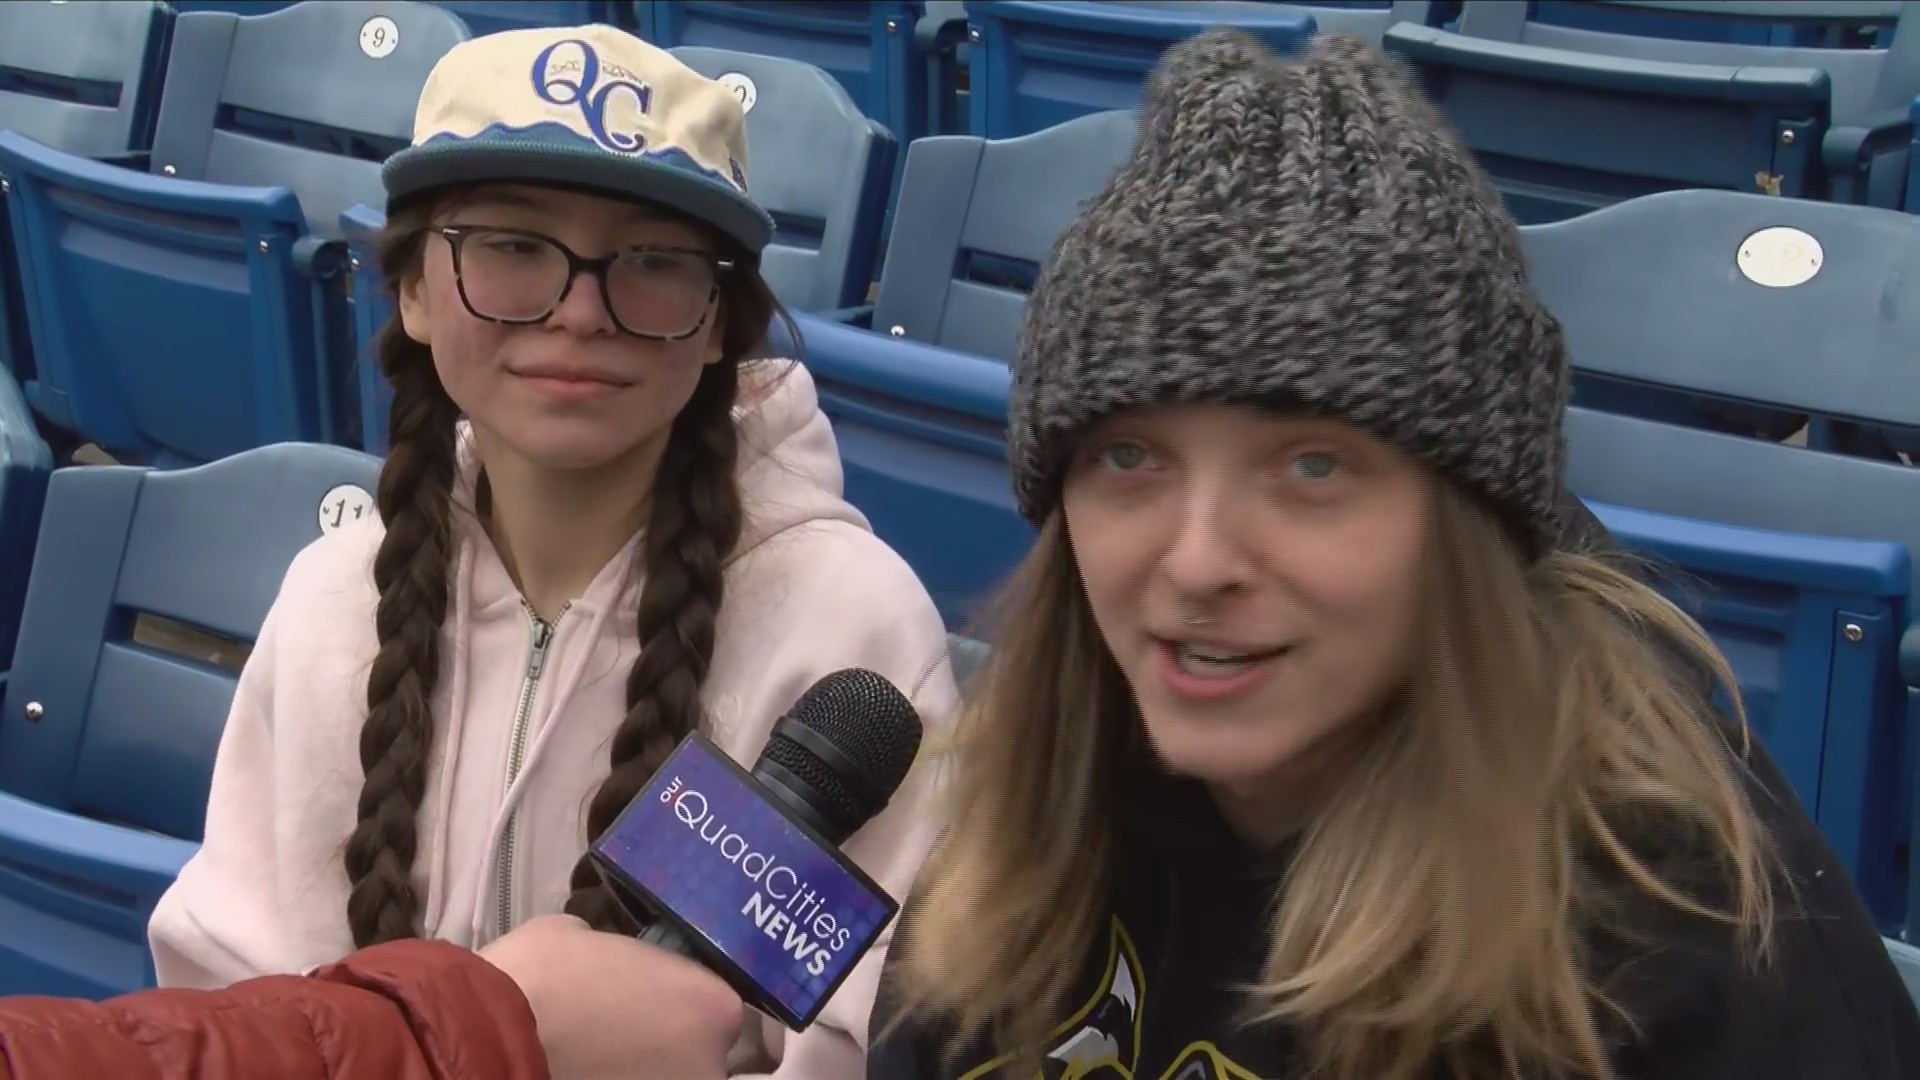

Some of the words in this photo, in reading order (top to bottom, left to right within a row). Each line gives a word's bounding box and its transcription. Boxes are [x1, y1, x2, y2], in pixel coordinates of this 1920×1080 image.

[373, 27, 385, 48] 9
[530, 39, 652, 153] QC
[741, 891, 832, 977] NEWS
